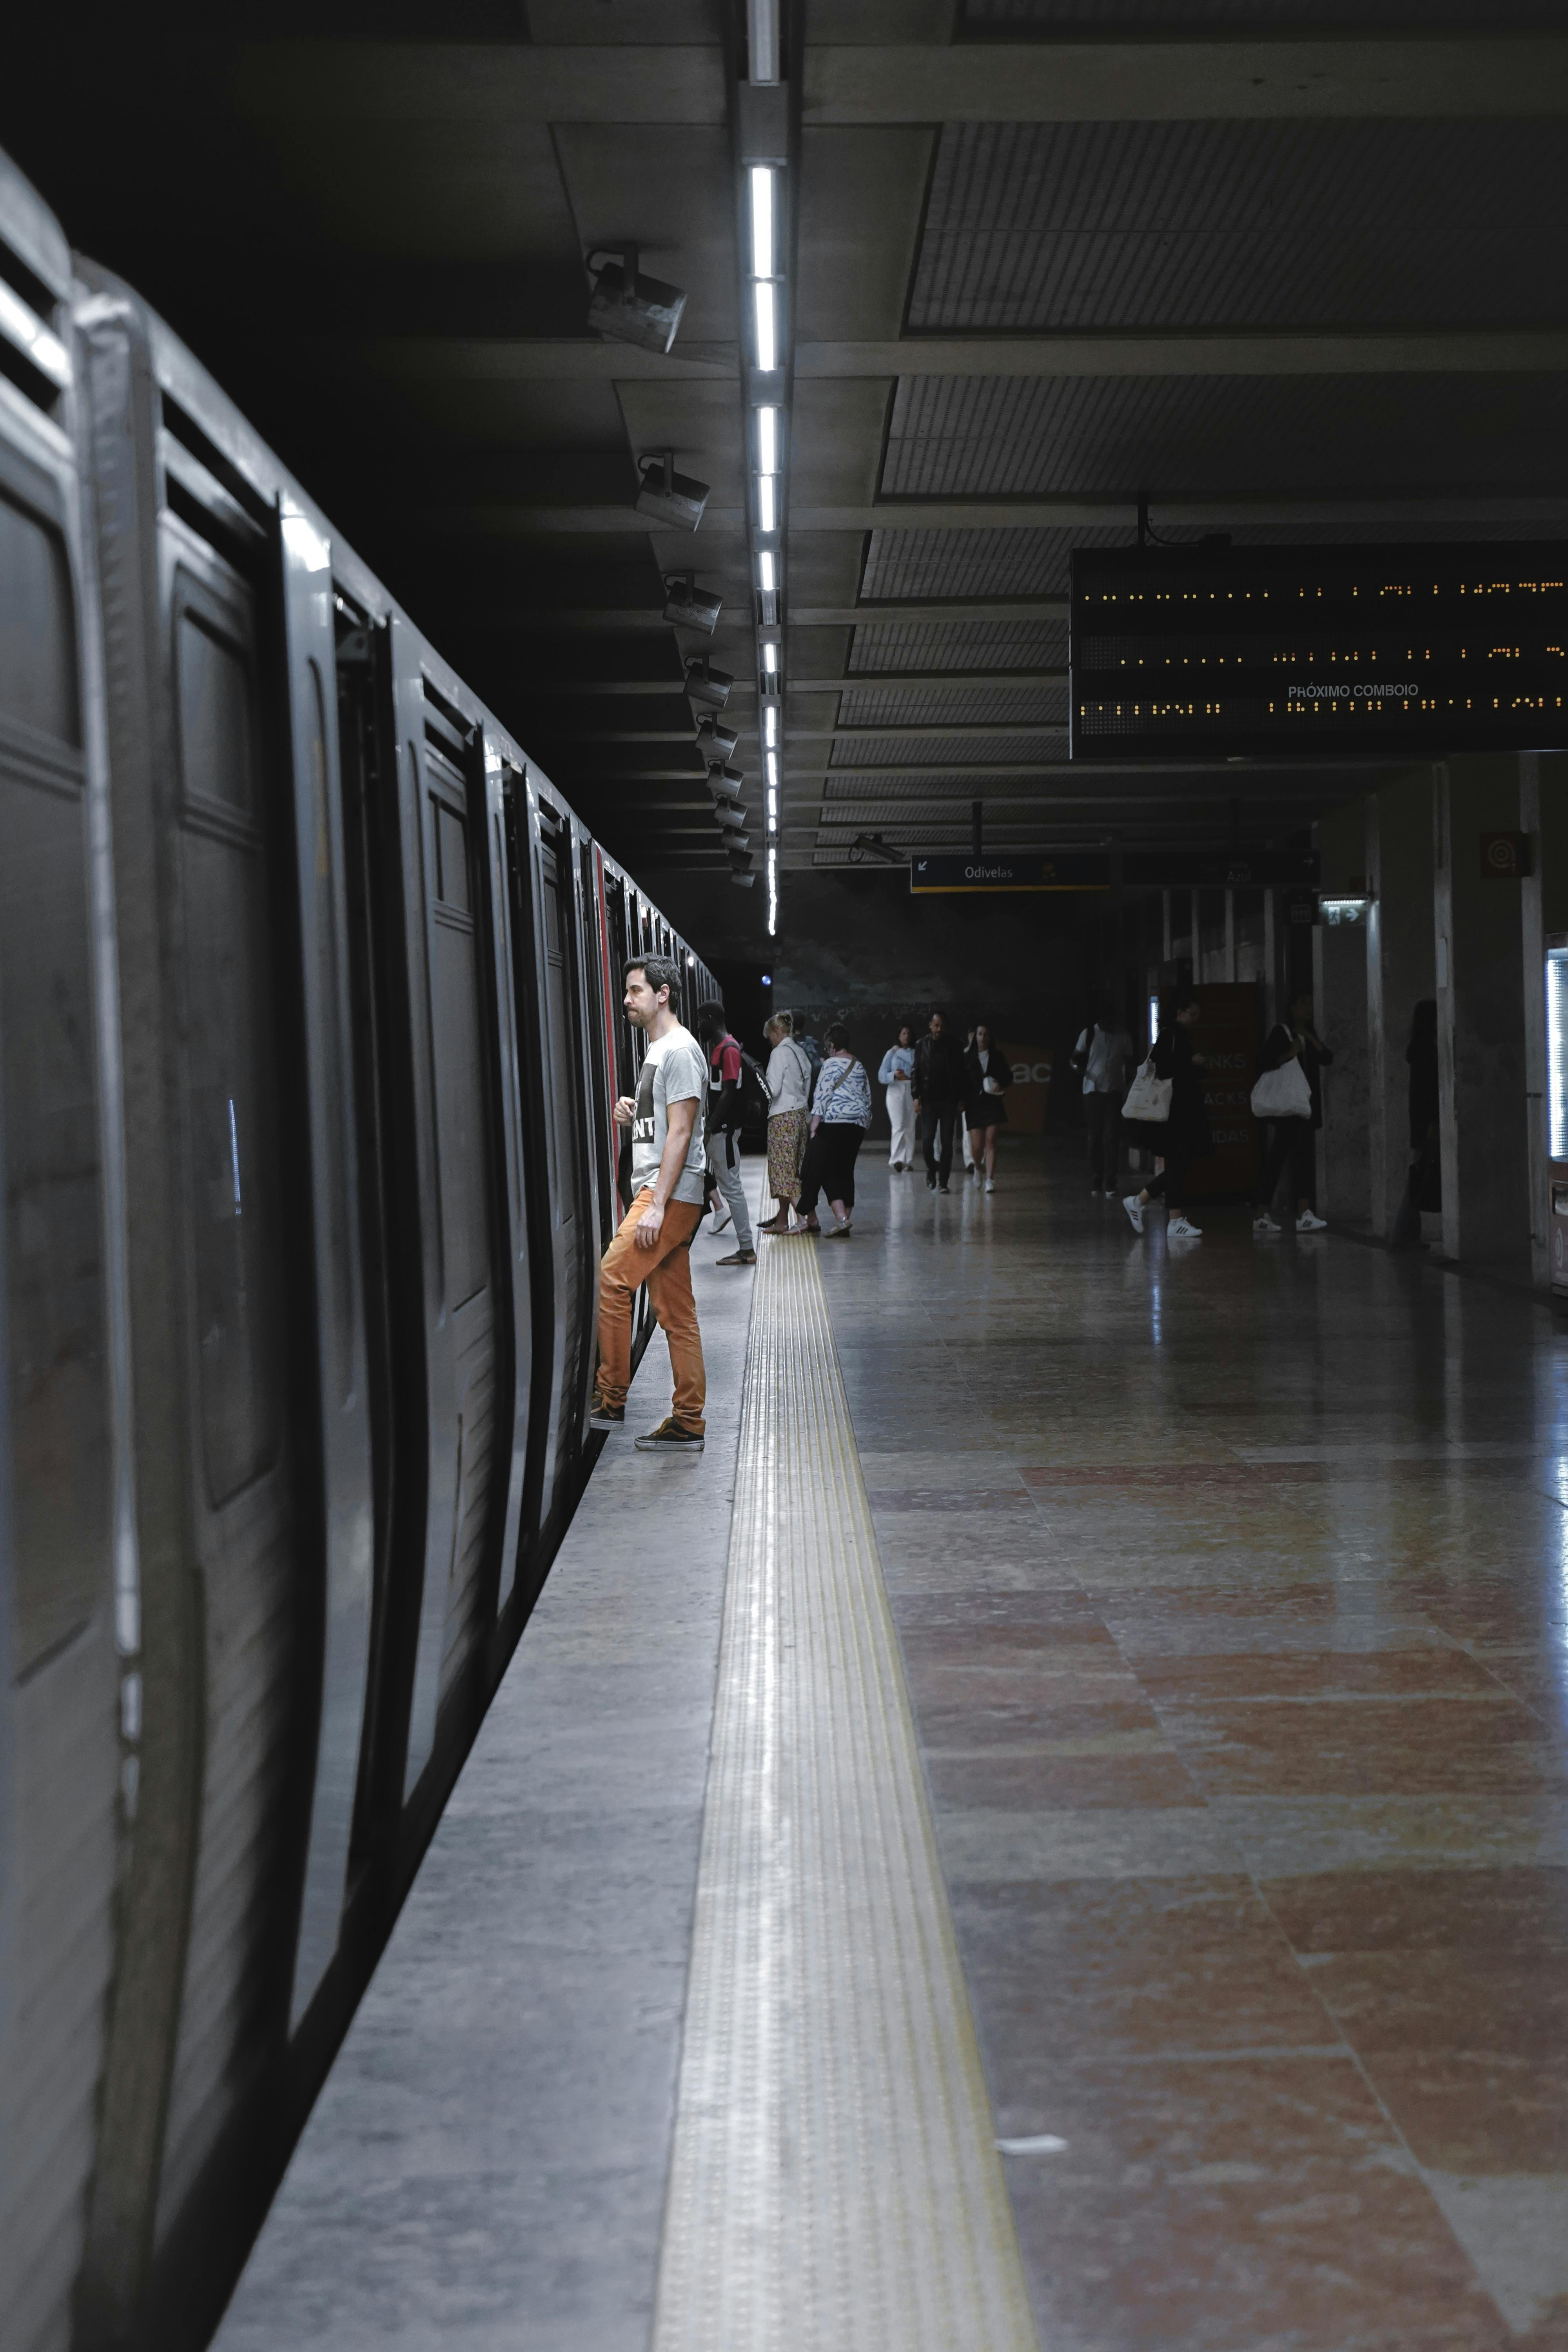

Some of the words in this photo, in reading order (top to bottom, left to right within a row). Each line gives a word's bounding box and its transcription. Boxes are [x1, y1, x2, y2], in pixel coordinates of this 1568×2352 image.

[1289, 682, 1350, 697] PRÓXIMO
[1354, 684, 1418, 697] COMBOIO
[965, 866, 1013, 878] Odivelas
[1227, 870, 1251, 882] Azul
[1207, 1054, 1246, 1069] NKS
[1010, 1063, 1052, 1083] ac
[1204, 1092, 1247, 1105] ACKS
[1212, 1129, 1249, 1143] IDAS
